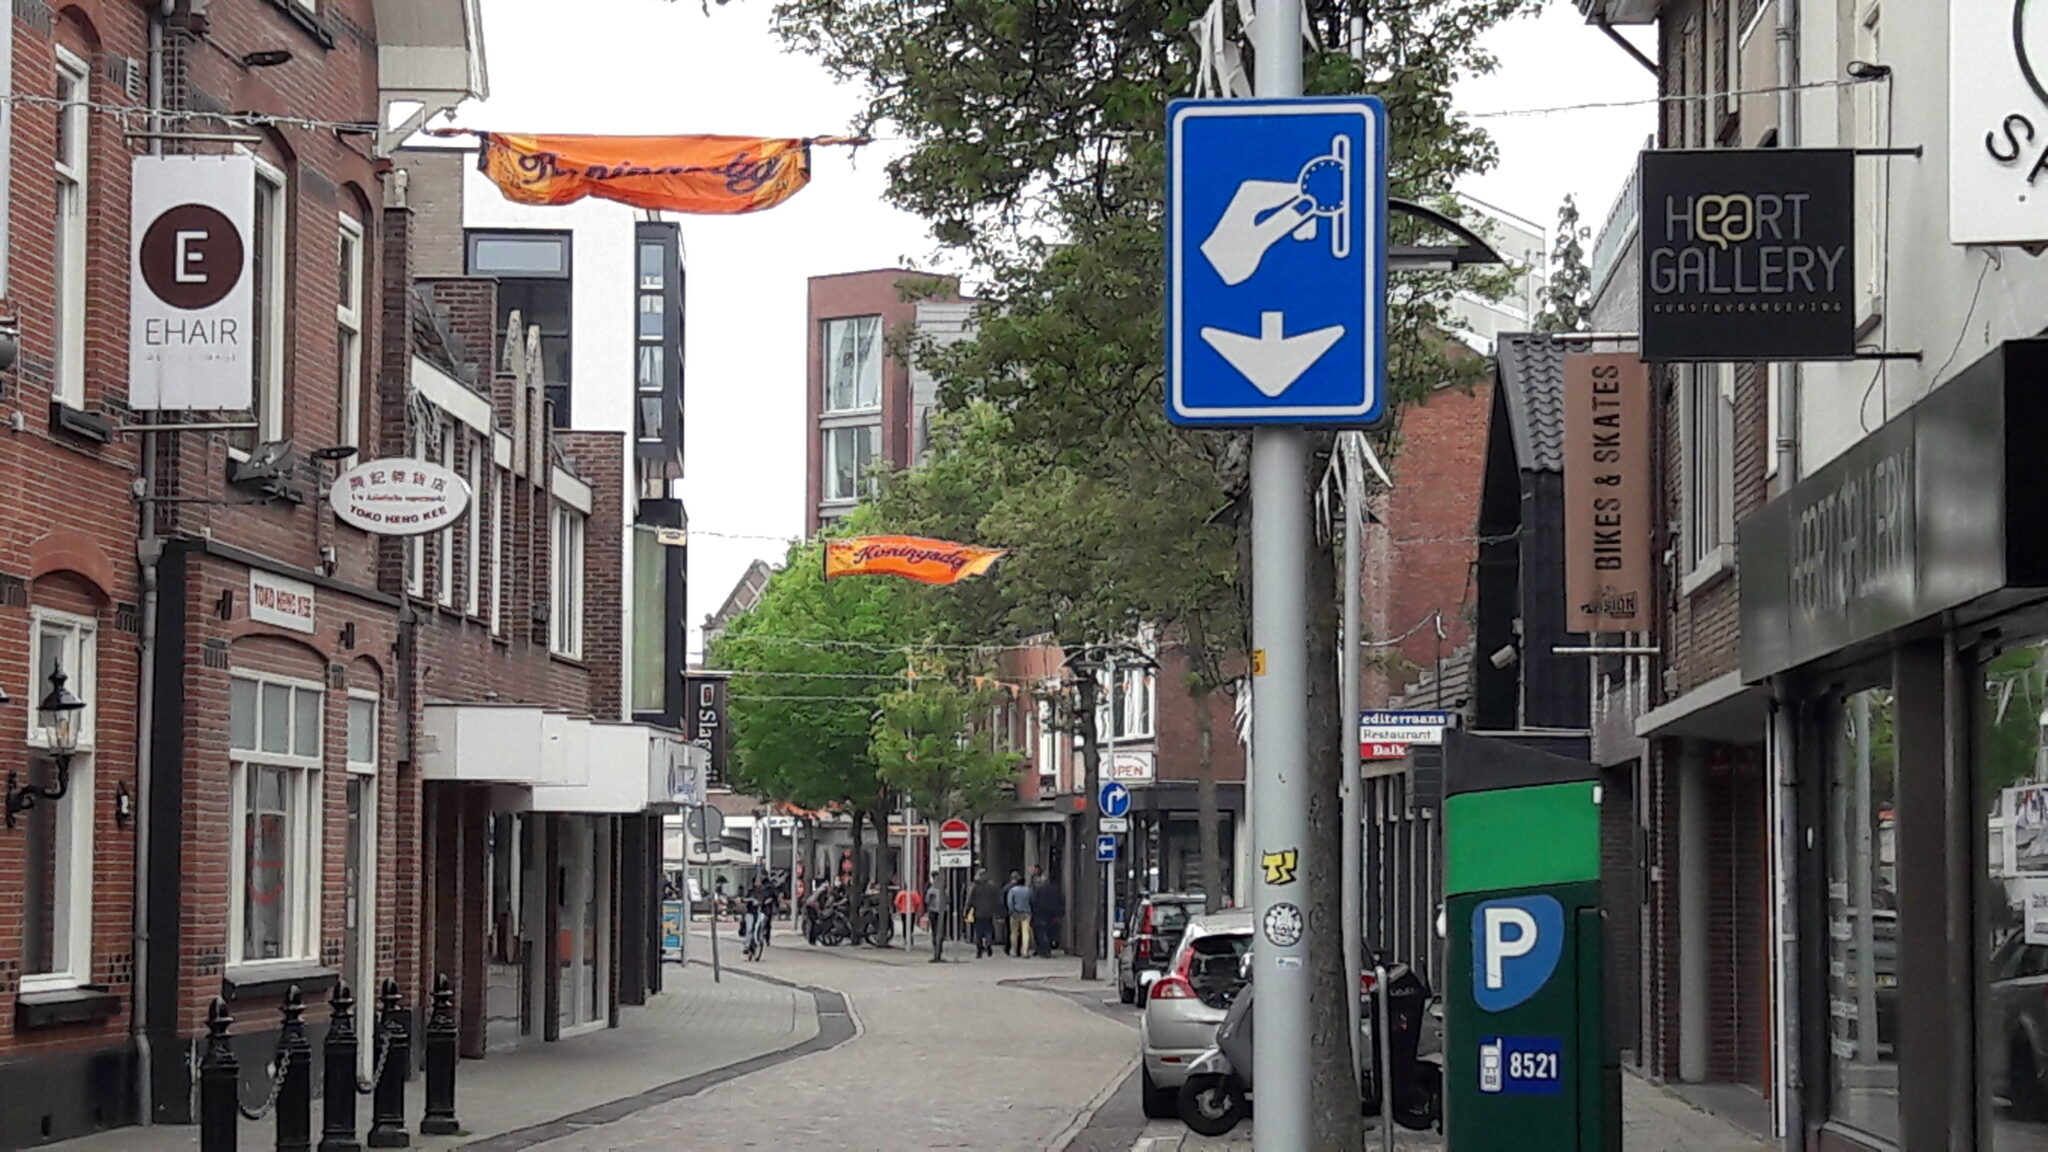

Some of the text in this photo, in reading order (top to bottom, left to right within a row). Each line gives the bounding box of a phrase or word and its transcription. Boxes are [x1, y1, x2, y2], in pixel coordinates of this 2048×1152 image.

[174, 230, 208, 282] E
[1650, 245, 1846, 294] GALLERY
[145, 318, 238, 345] EHAIR
[1591, 364, 1621, 463] SKATES
[350, 504, 382, 521] TOKO
[423, 506, 447, 520] KEE
[1594, 498, 1622, 571] BIKES
[1363, 729, 1432, 739] Restaurant
[1372, 744, 1407, 756] Balk
[1484, 907, 1538, 989] P
[1510, 1051, 1557, 1079] 8521
